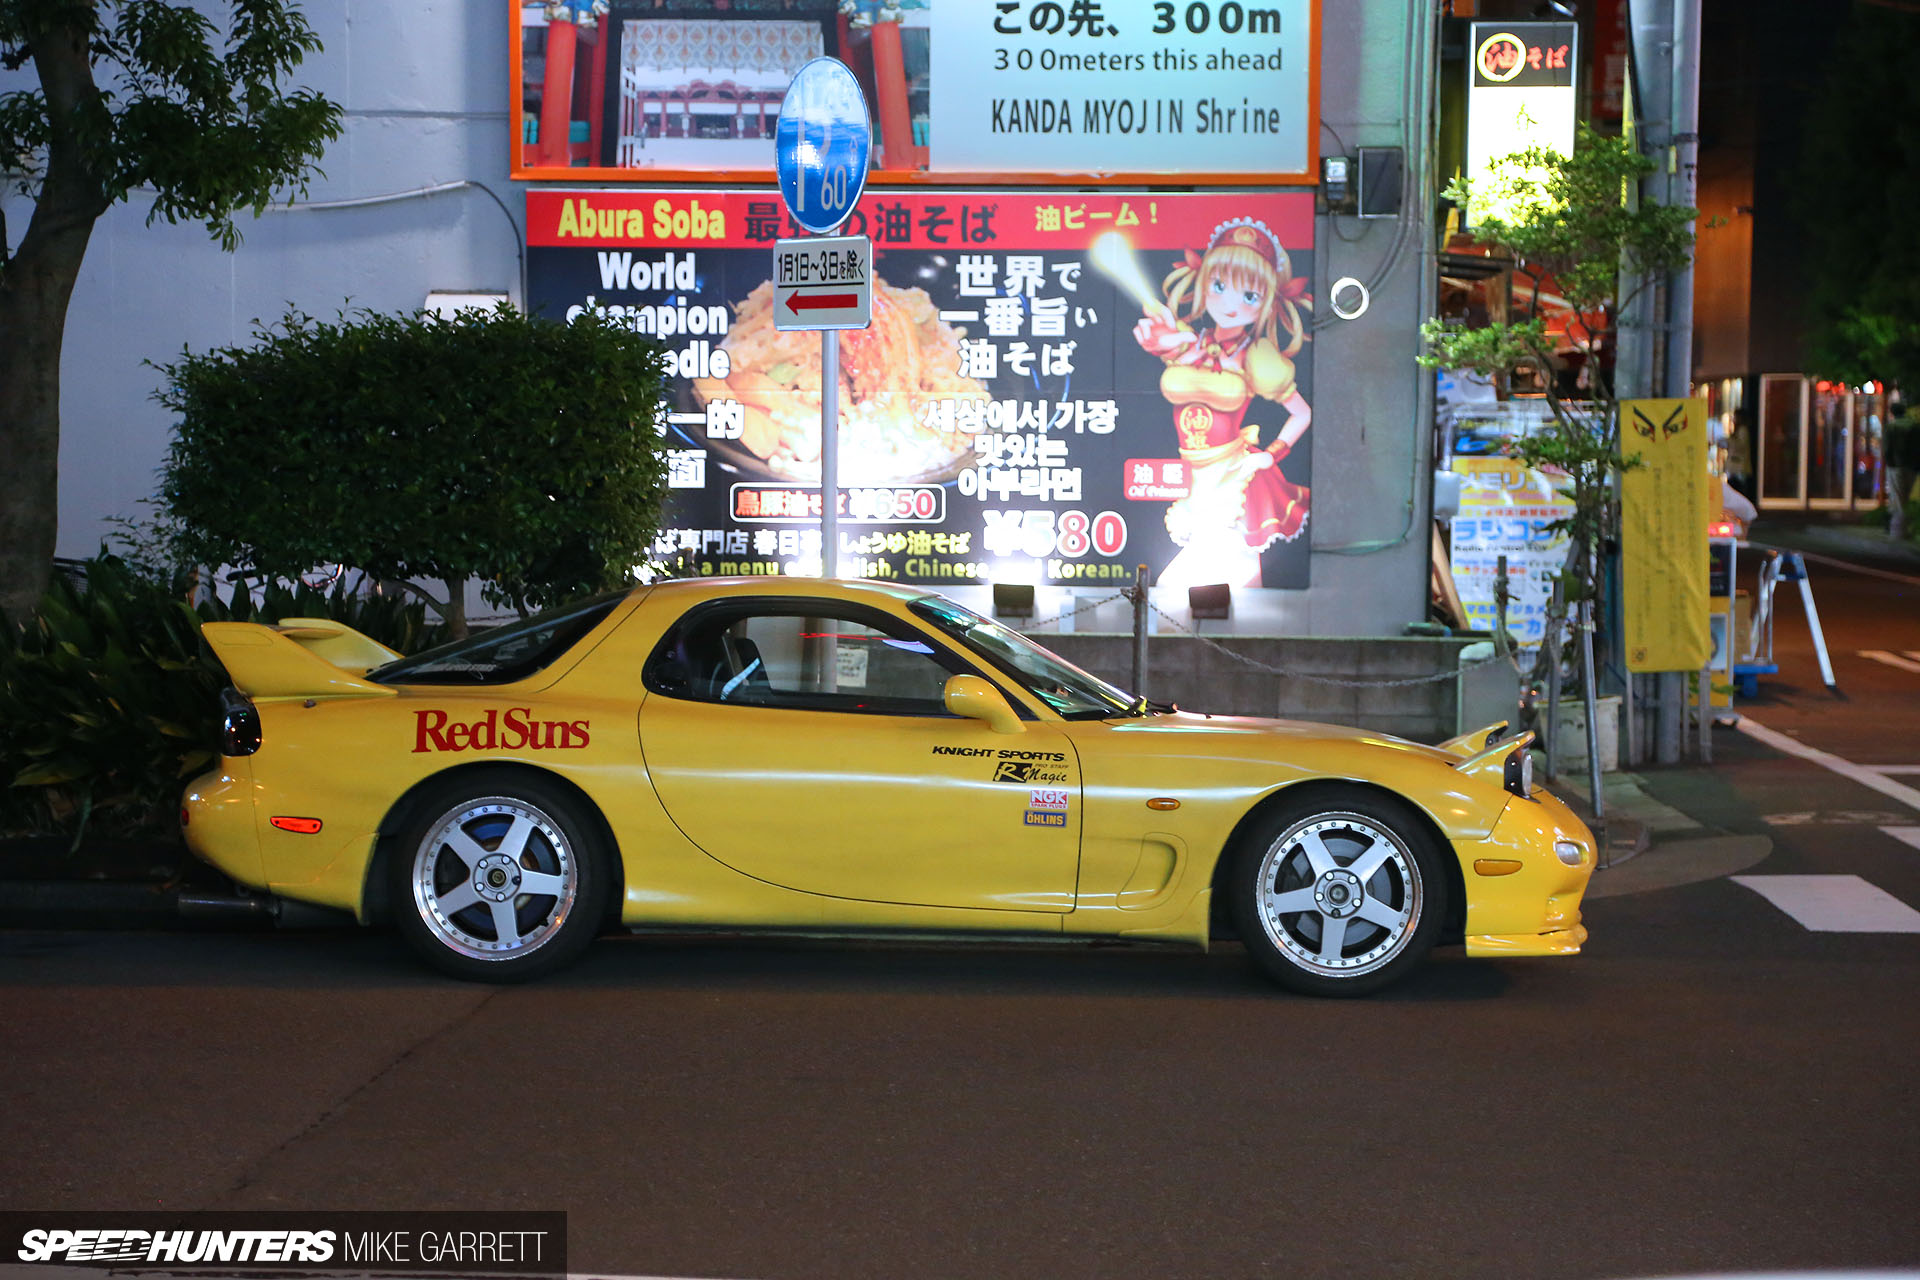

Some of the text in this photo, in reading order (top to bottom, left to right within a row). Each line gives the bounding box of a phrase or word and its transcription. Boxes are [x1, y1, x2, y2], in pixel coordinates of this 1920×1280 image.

[993, 0, 1282, 38] この先、 300m
[994, 47, 1283, 71] 300meters this ahead
[992, 97, 1280, 134] KANDA MYOJIN Shrine
[821, 165, 846, 211] 60
[557, 198, 726, 239] Abura Soba
[597, 251, 696, 291] World
[956, 254, 1082, 297] 世界で
[939, 296, 1098, 336] 一番旨い
[645, 340, 731, 379] odle
[957, 338, 1077, 379] 油そば
[924, 399, 1119, 434] 세상에서 가장
[974, 433, 1069, 467] 맛있는
[701, 561, 713, 576] a
[720, 560, 780, 576] menu
[905, 559, 989, 578] Chinese
[1047, 559, 1132, 579] Korean.
[932, 745, 1065, 762] KNIGHT SPORTS
[1023, 767, 1067, 785] Magic
[1030, 790, 1067, 804] NGK
[1026, 811, 1064, 826] ÖHLINS
